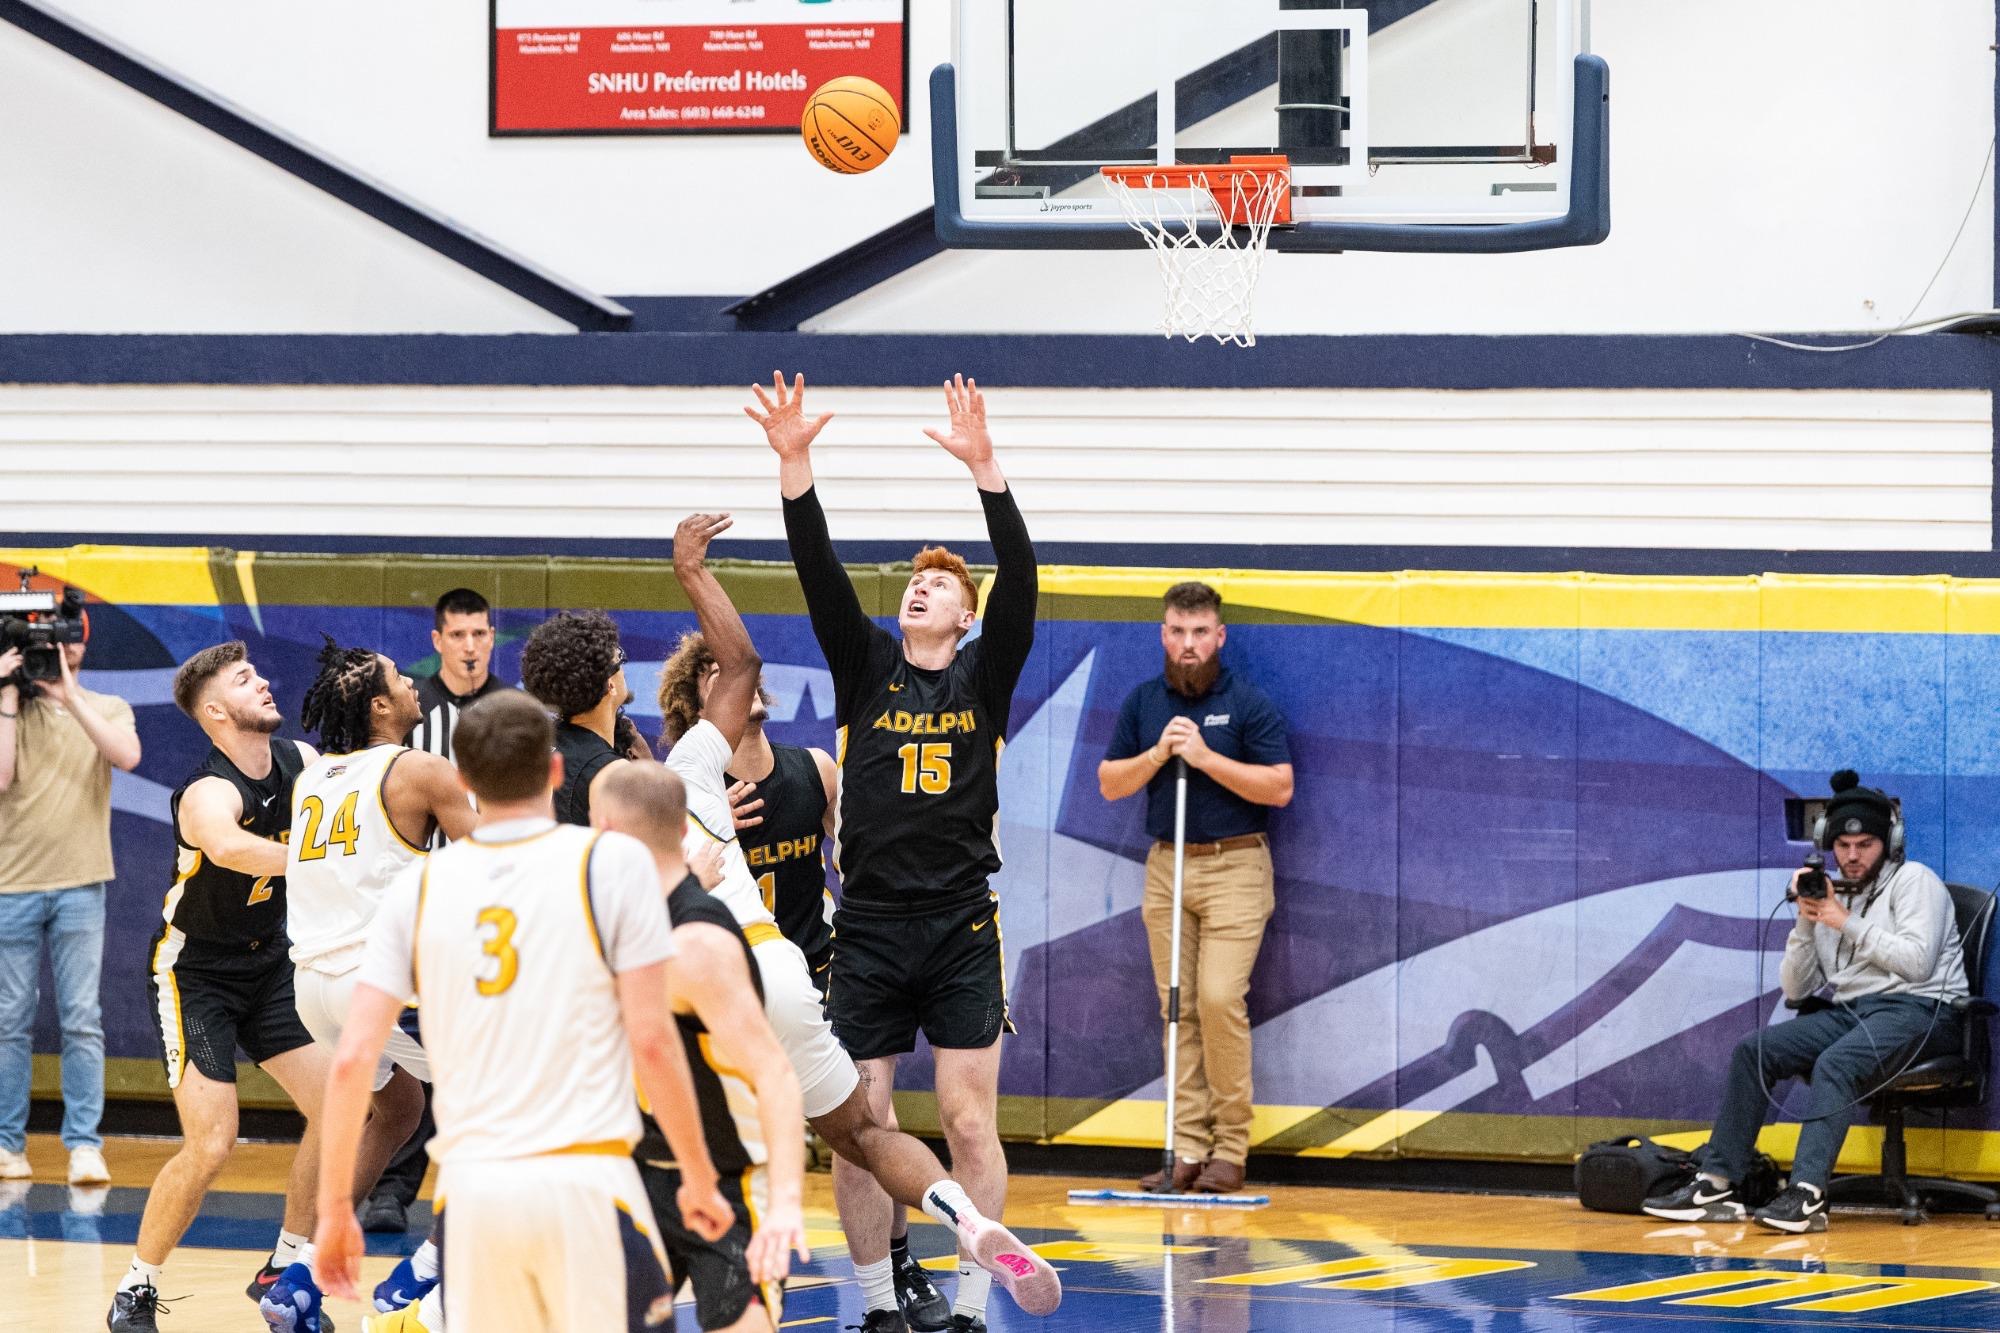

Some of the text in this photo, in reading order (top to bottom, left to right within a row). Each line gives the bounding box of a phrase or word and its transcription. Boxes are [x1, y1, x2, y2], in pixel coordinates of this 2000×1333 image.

[588, 69, 807, 94] SNHU Preferred Hotels
[620, 107, 646, 120] Area
[647, 106, 679, 119] Sales:
[681, 106, 710, 119] (603)
[837, 136, 871, 161] EVO
[872, 709, 976, 734] ADELPHI
[898, 742, 952, 794] 15
[298, 790, 361, 862] 24
[743, 834, 817, 866] ELPHI
[247, 875, 273, 906] 2
[474, 905, 521, 997] 3
